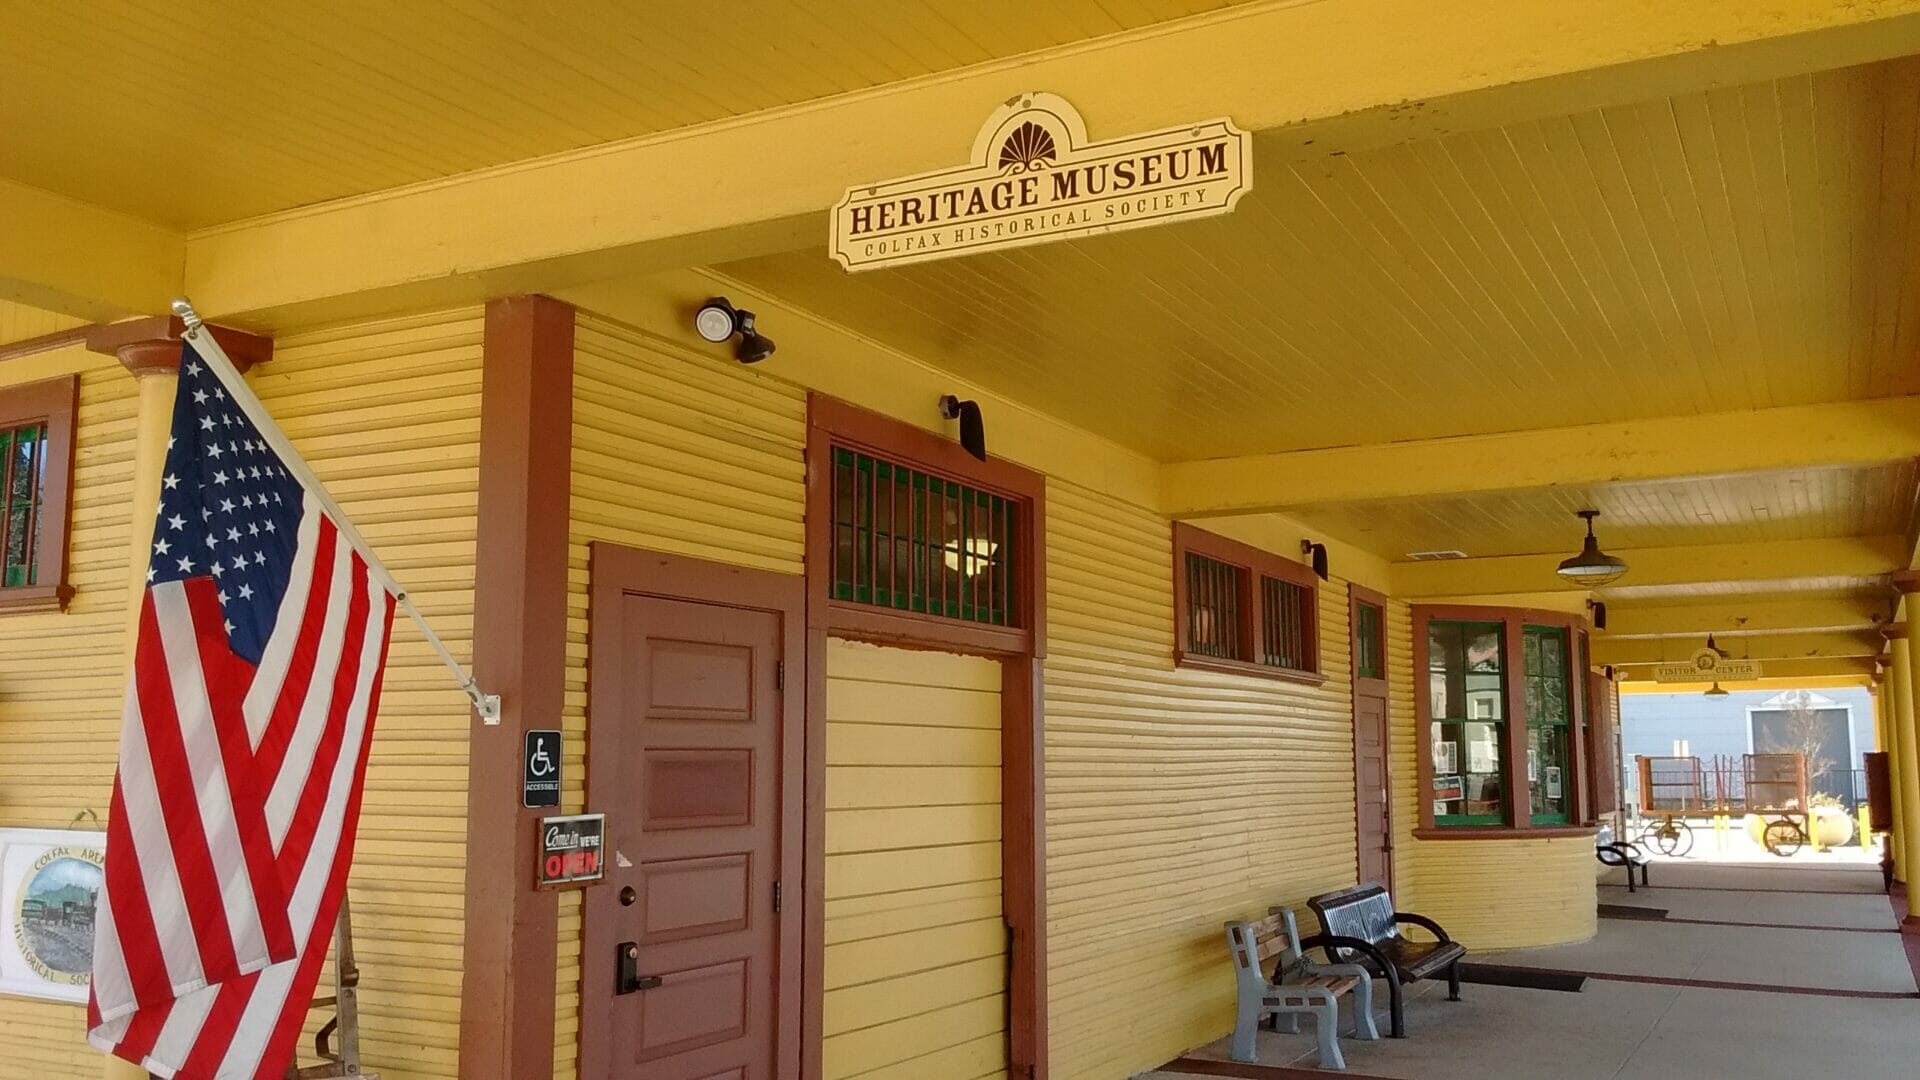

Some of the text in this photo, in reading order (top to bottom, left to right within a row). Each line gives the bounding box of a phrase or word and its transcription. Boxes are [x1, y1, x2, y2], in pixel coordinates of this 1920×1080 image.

[850, 142, 1228, 235] HERITAGE MUSEUM
[865, 188, 1208, 257] COLFAX HISTORICAL SOCIETY
[1658, 665, 1753, 675] VISITOR CENTER
[526, 783, 558, 791] ACCESSIBLE
[546, 827, 569, 847] Come
[34, 847, 70, 871] COLFAX
[546, 852, 599, 877] OPEN
[14, 924, 57, 983] HISTORICAL
